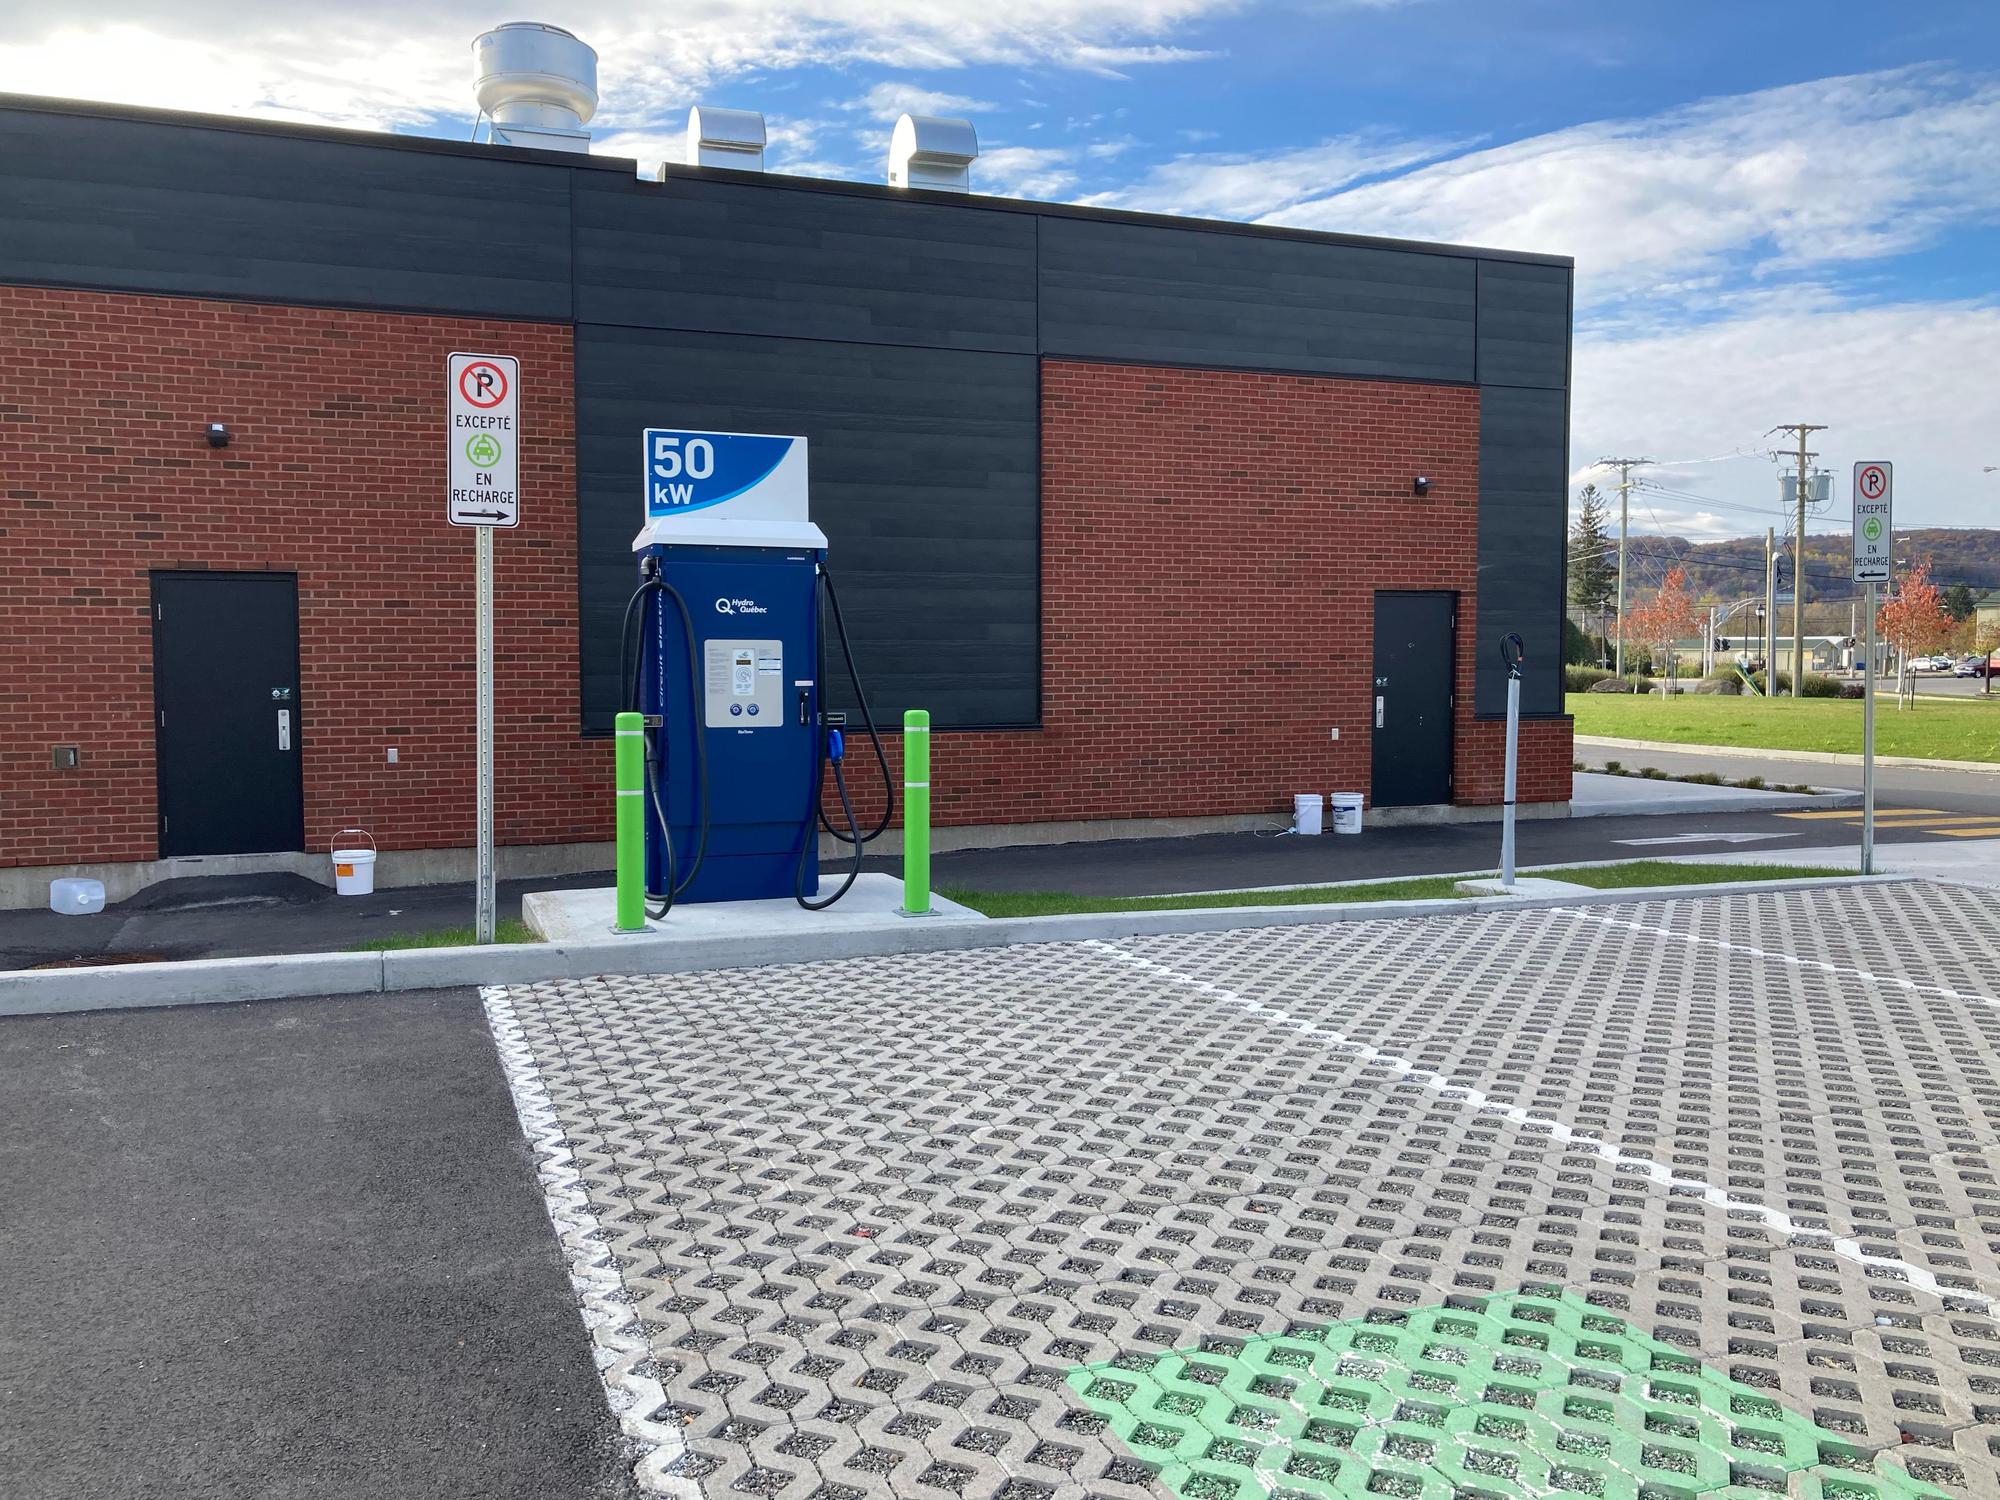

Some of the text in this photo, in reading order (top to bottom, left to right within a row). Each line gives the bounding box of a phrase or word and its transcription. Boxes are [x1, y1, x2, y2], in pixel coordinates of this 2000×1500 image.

[456, 414, 511, 430] EXCEPTÉ
[654, 436, 714, 480] 50
[476, 472, 492, 486] EN
[453, 488, 515, 504] RECHARGE
[654, 483, 694, 505] kW
[1857, 503, 1888, 514] EXCEPTÉ
[1867, 544, 1877, 554] EN
[1855, 556, 1889, 566] RECHARGE
[732, 599, 754, 607] Hydro
[740, 605, 768, 614] Québec
